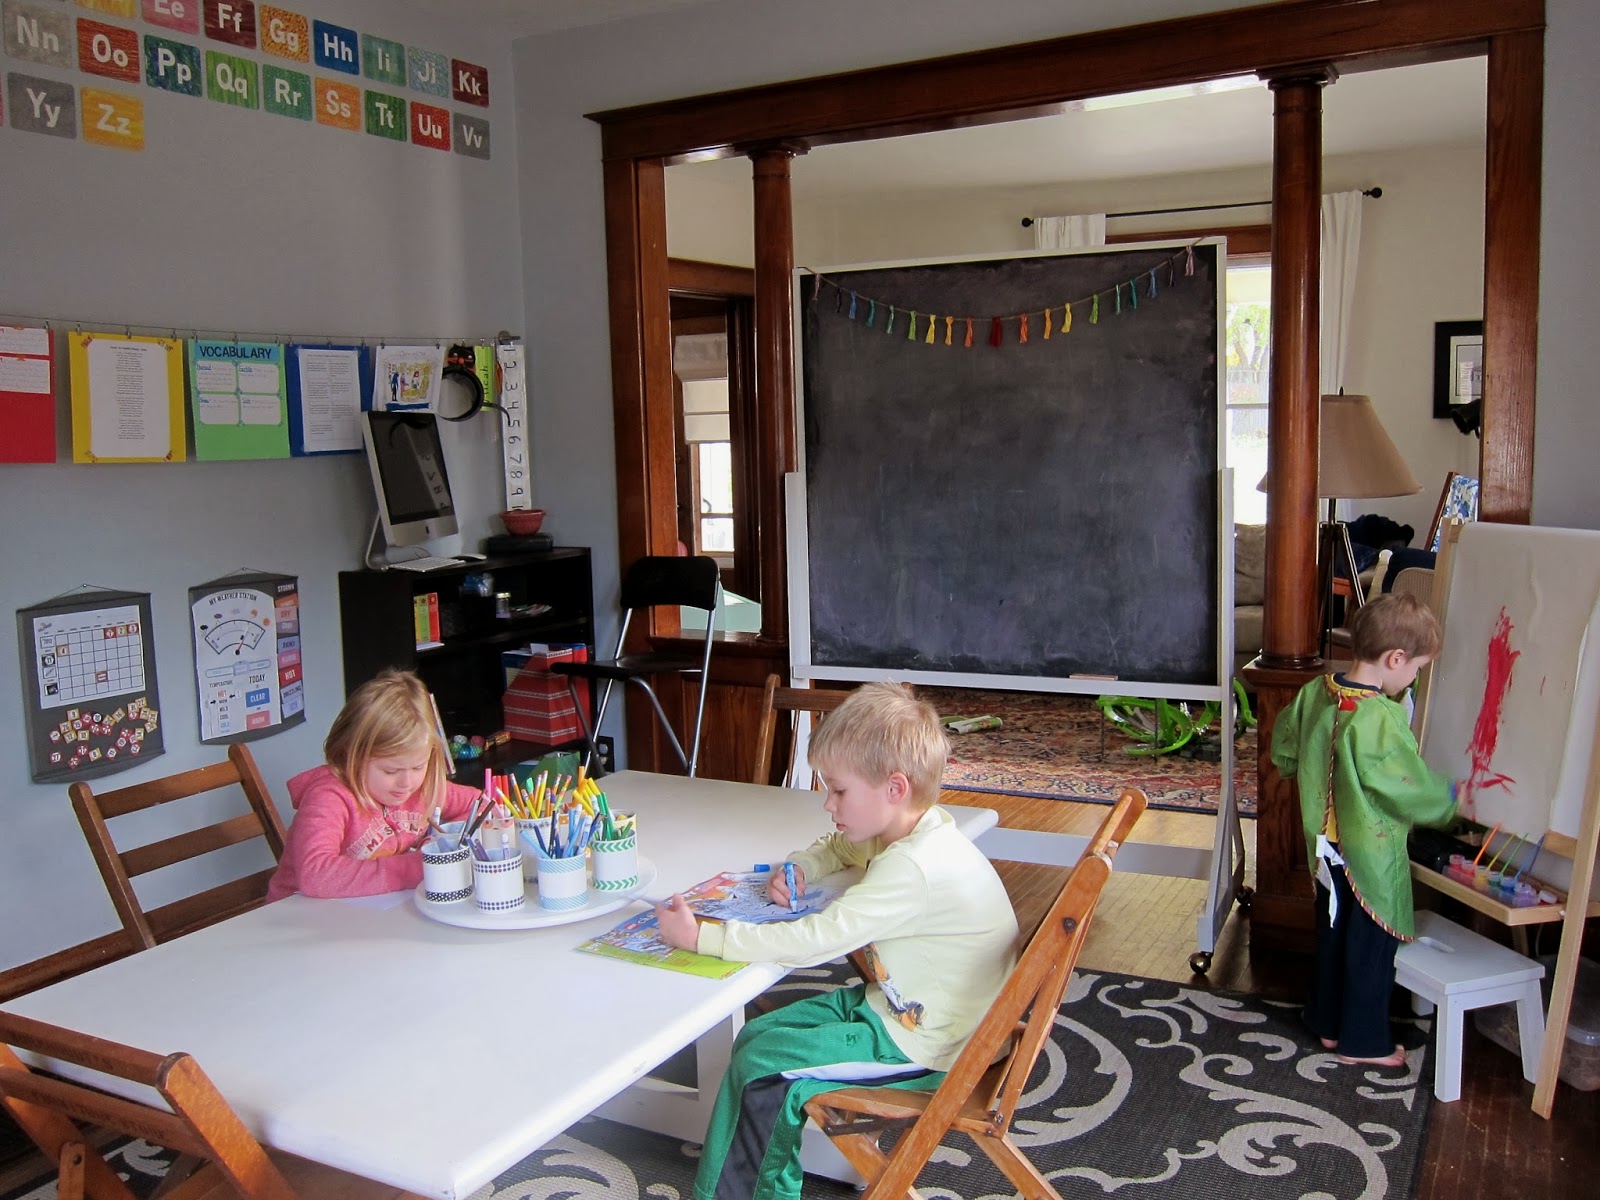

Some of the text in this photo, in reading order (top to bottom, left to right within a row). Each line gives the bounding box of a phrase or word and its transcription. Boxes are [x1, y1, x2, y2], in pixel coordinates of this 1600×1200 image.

[218, 3, 242, 33] Ff
[269, 18, 299, 50] Gg
[323, 32, 353, 62] Hh
[377, 48, 390, 72] Ii
[458, 70, 482, 96] Kk
[17, 15, 483, 148] Nn Oo Pp Qq Rr Ss Tt Uu Vv
[26, 87, 131, 135] Yy Zz
[200, 345, 272, 359] VOCABULARY
[504, 360, 517, 373] 2
[505, 382, 518, 392] 3
[507, 401, 519, 409] 4
[509, 420, 520, 428] 5
[509, 435, 521, 445] 6
[510, 453, 522, 464] 7
[510, 470, 523, 479] 8
[511, 487, 524, 496] 9
[218, 592, 238, 601] WEATHER
[249, 674, 265, 684] TODAY
[285, 670, 296, 680] HOT
[250, 692, 266, 703] CLEAR
